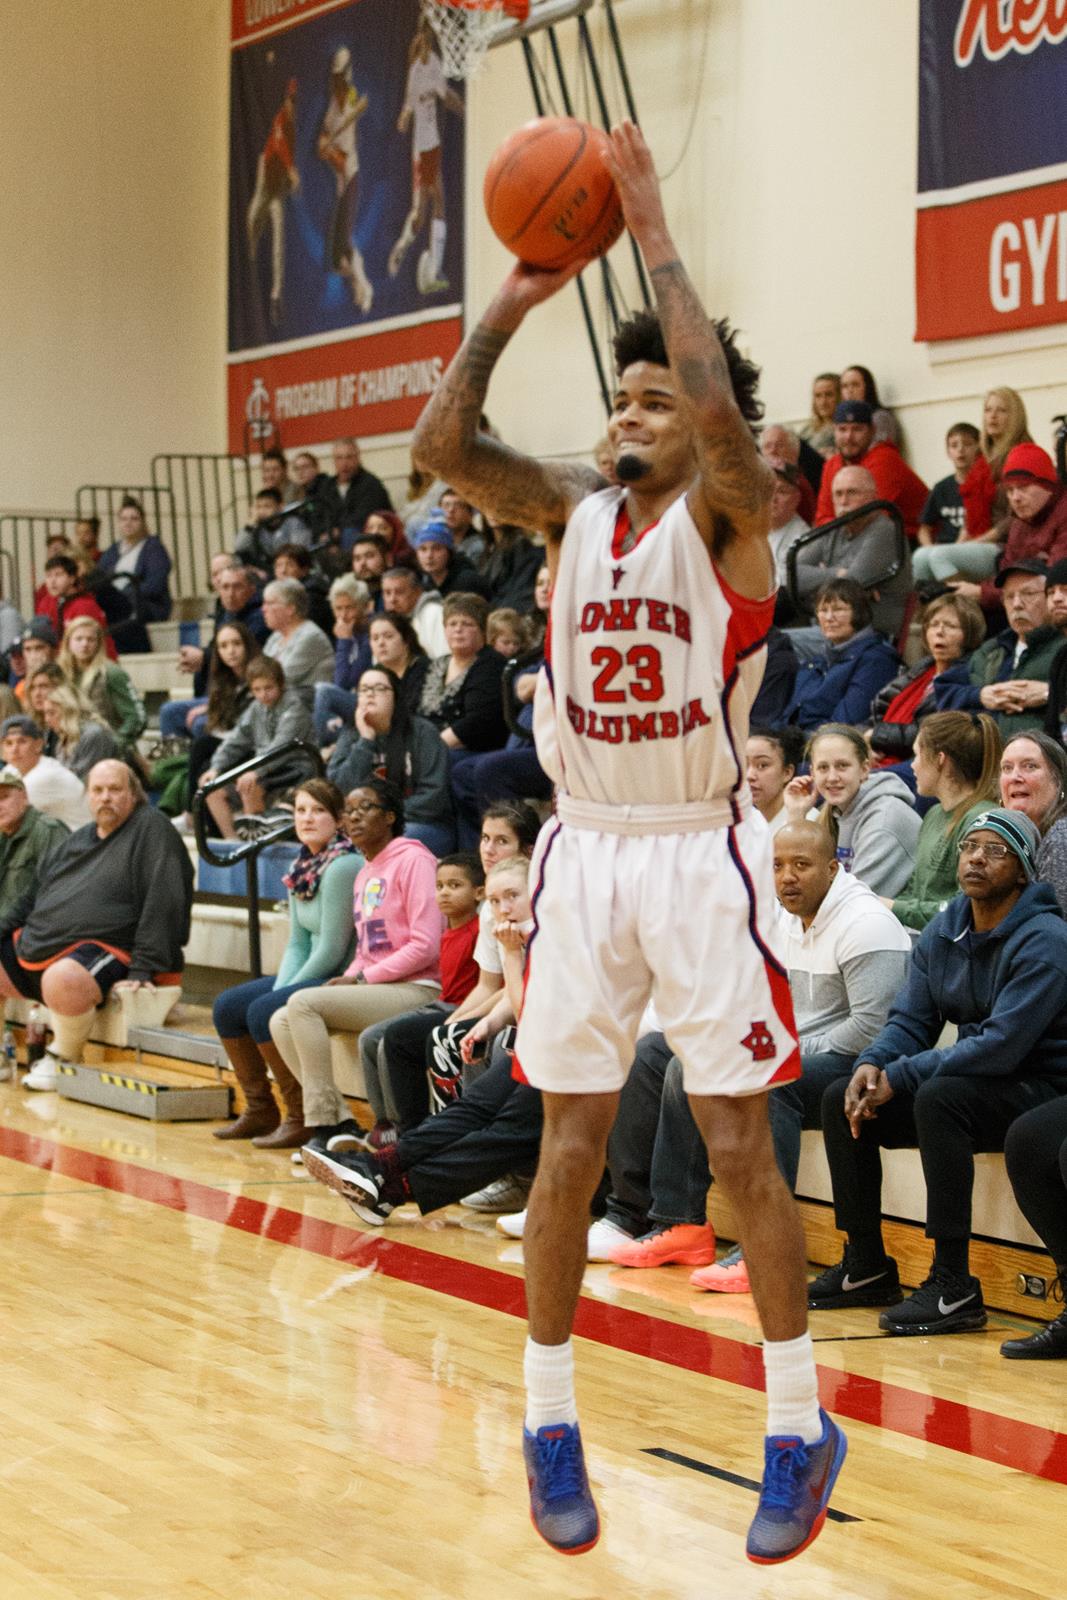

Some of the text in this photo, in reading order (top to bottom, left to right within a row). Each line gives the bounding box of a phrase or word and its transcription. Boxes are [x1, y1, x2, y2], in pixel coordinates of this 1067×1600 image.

[989, 210, 1067, 313] GY
[275, 377, 338, 420] PROGRAM
[339, 373, 356, 409] OF
[358, 355, 443, 407] CHAMPIONS
[591, 644, 665, 703] 23
